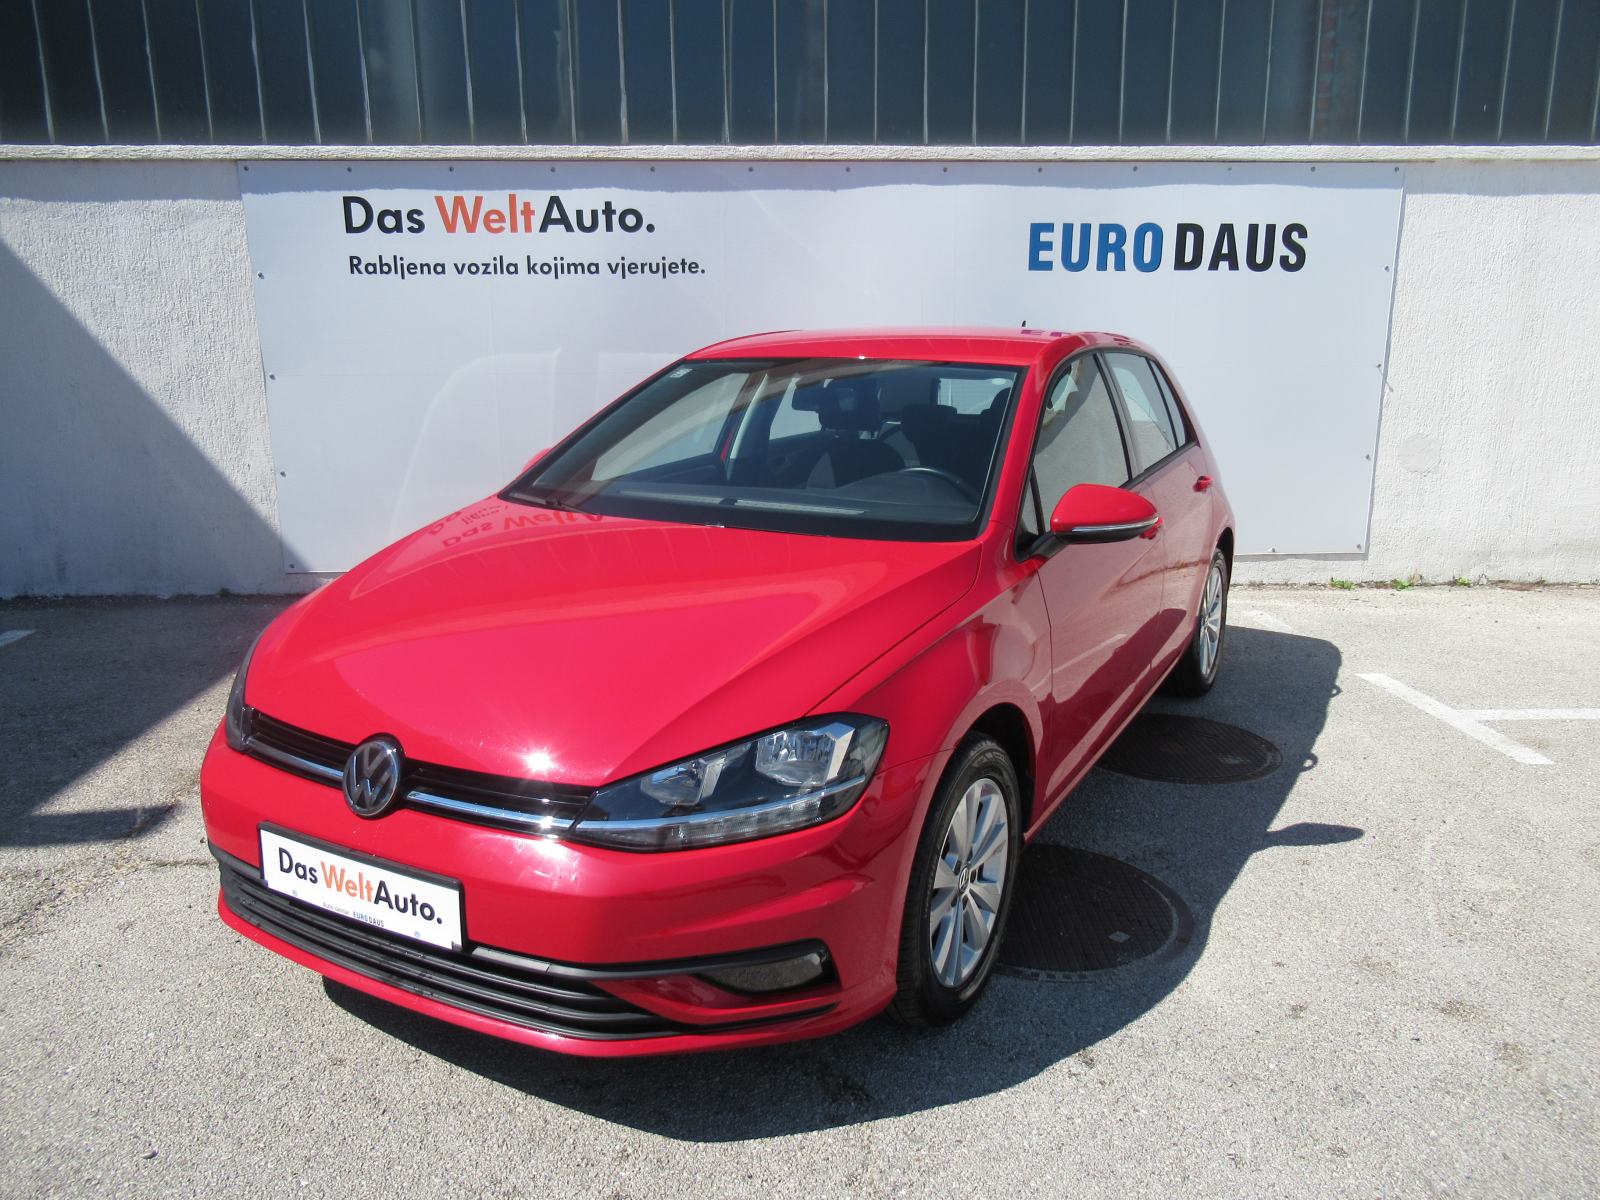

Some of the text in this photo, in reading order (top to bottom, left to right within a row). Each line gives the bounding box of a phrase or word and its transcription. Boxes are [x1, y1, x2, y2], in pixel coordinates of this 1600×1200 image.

[343, 195, 425, 234] Das
[349, 255, 706, 279] Rabljena vozila kojima vjerujete.
[278, 847, 318, 884] Das
